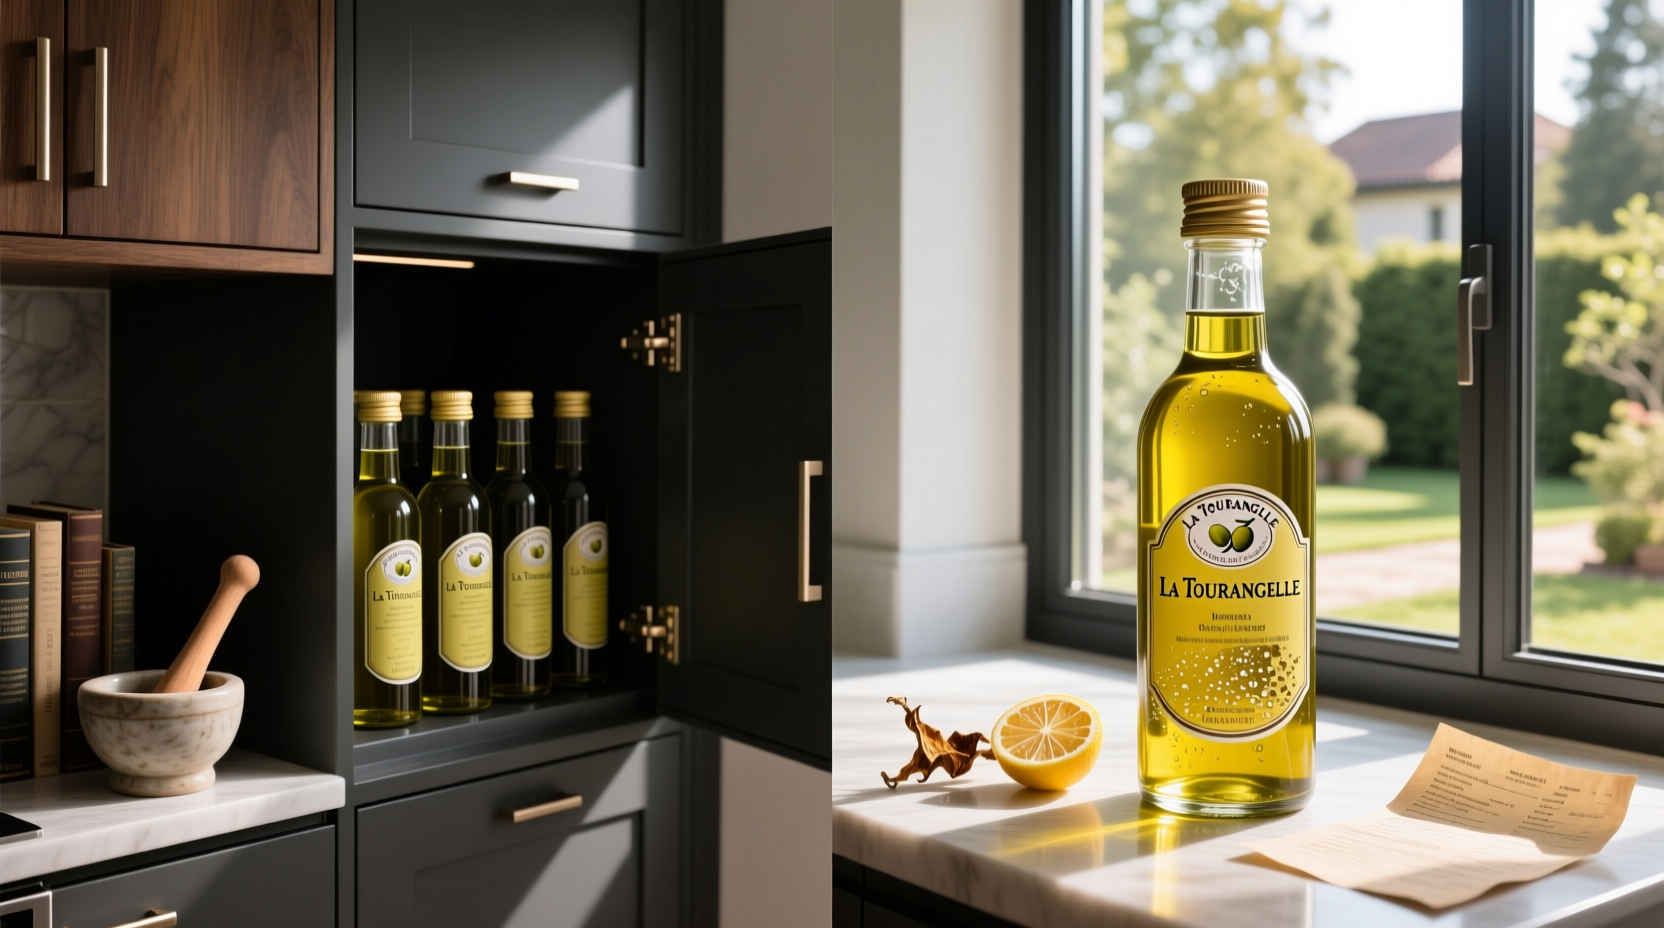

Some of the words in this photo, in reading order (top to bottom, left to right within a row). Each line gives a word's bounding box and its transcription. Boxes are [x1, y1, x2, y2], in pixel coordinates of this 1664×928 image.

[1182, 514, 1200, 530] LA
[1159, 576, 1179, 598] LA
[1183, 577, 1301, 599] TOURANGELLE
